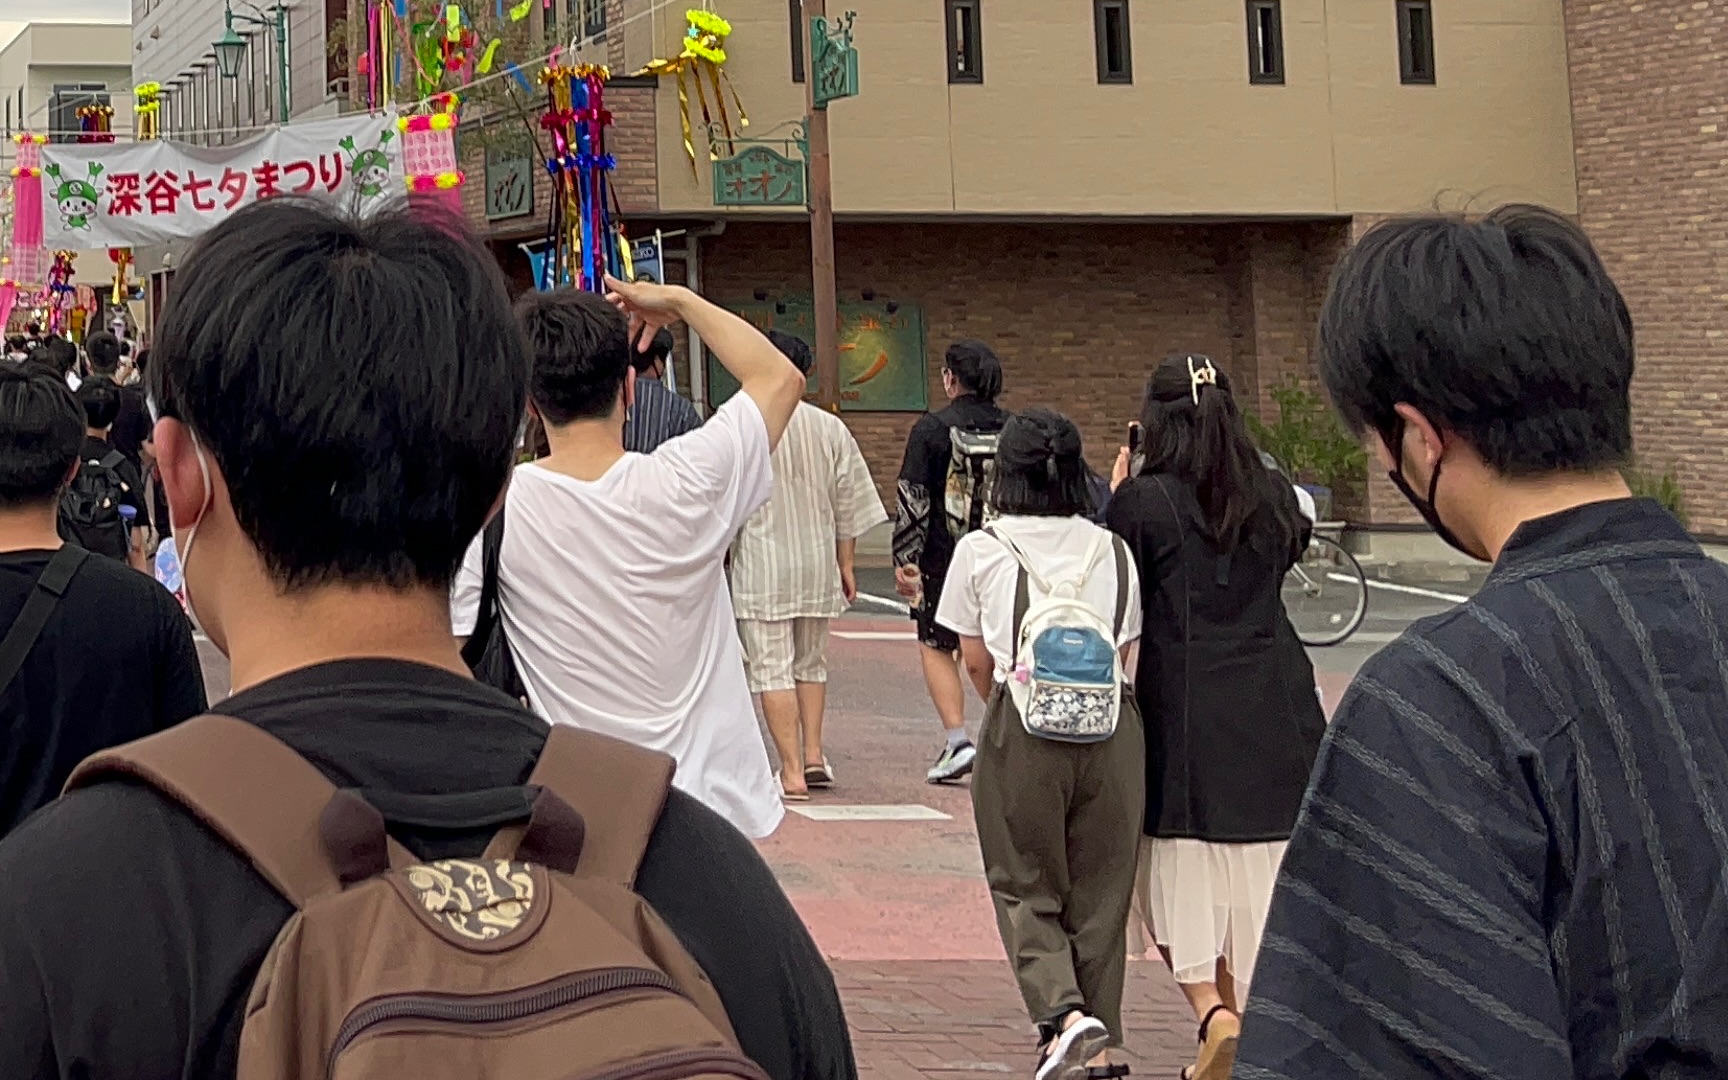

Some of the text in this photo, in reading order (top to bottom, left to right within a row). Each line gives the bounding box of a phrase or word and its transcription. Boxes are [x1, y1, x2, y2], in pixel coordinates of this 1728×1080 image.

[106, 151, 344, 216] 深谷七夕まつり
